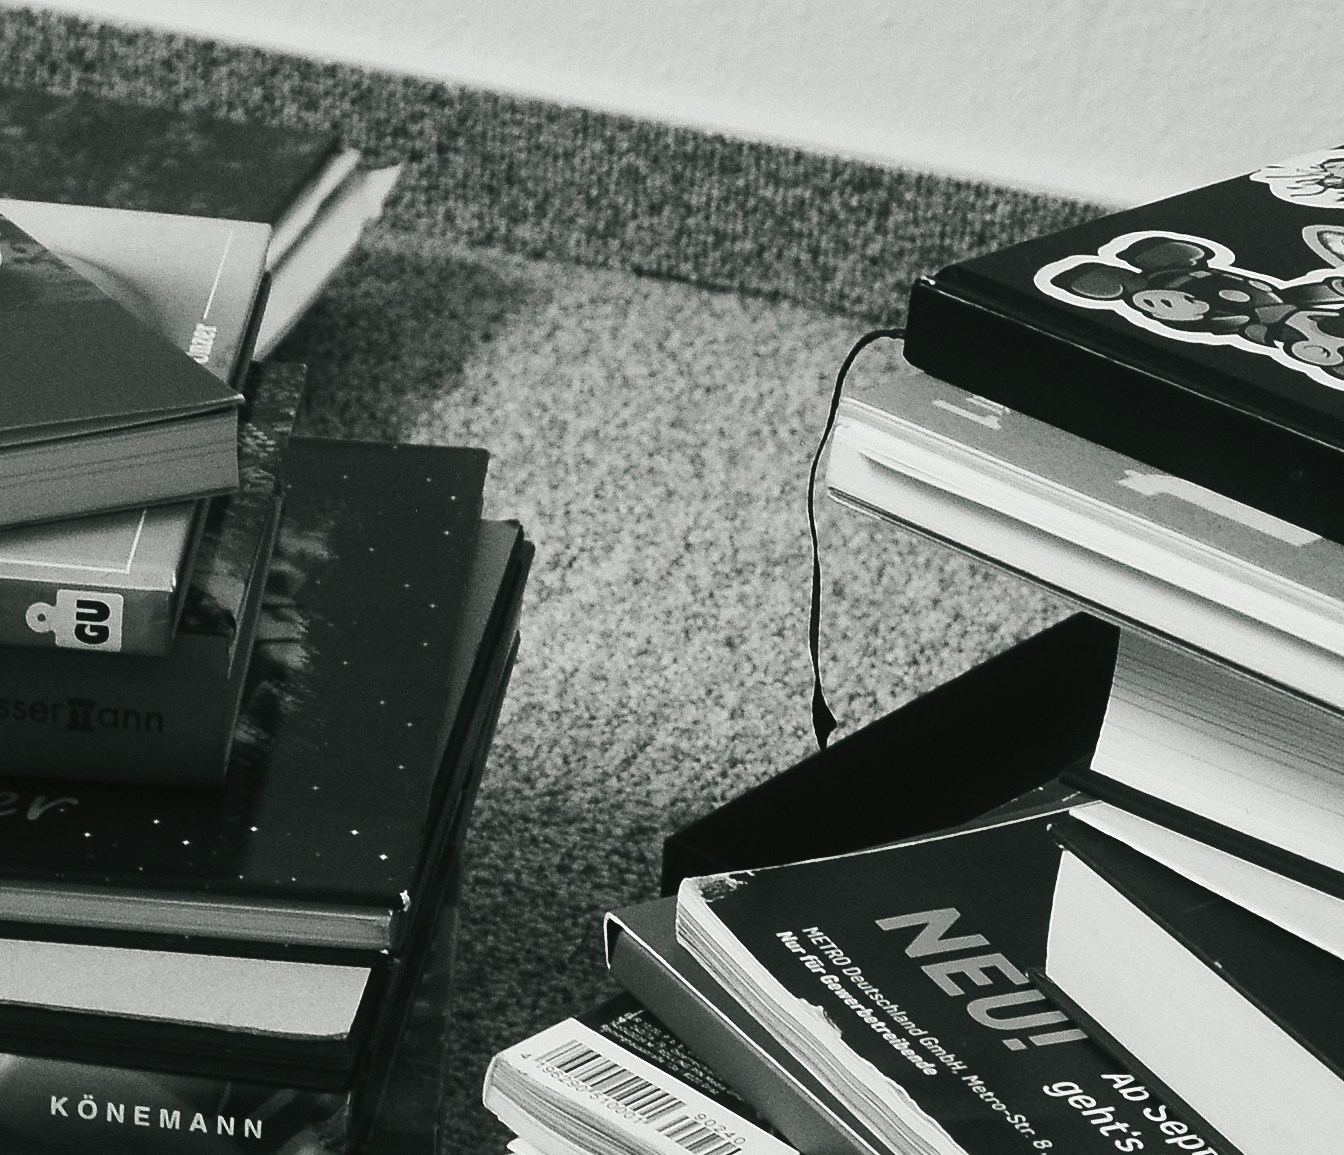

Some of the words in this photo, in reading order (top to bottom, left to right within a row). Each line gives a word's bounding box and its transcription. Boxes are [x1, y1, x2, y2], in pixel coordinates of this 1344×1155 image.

[74, 599, 111, 645] GU
[802, 926, 852, 966] METRO
[842, 966, 929, 1037] Deutschland
[874, 907, 1088, 1051] NEU!
[775, 931, 807, 957] Nur
[799, 953, 827, 975] für
[820, 974, 938, 1076] Gewerbetreibende
[1100, 1073, 1150, 1102] Ab
[49, 1093, 264, 1140] KÖNEMANN
[693, 1112, 747, 1146] 90240
